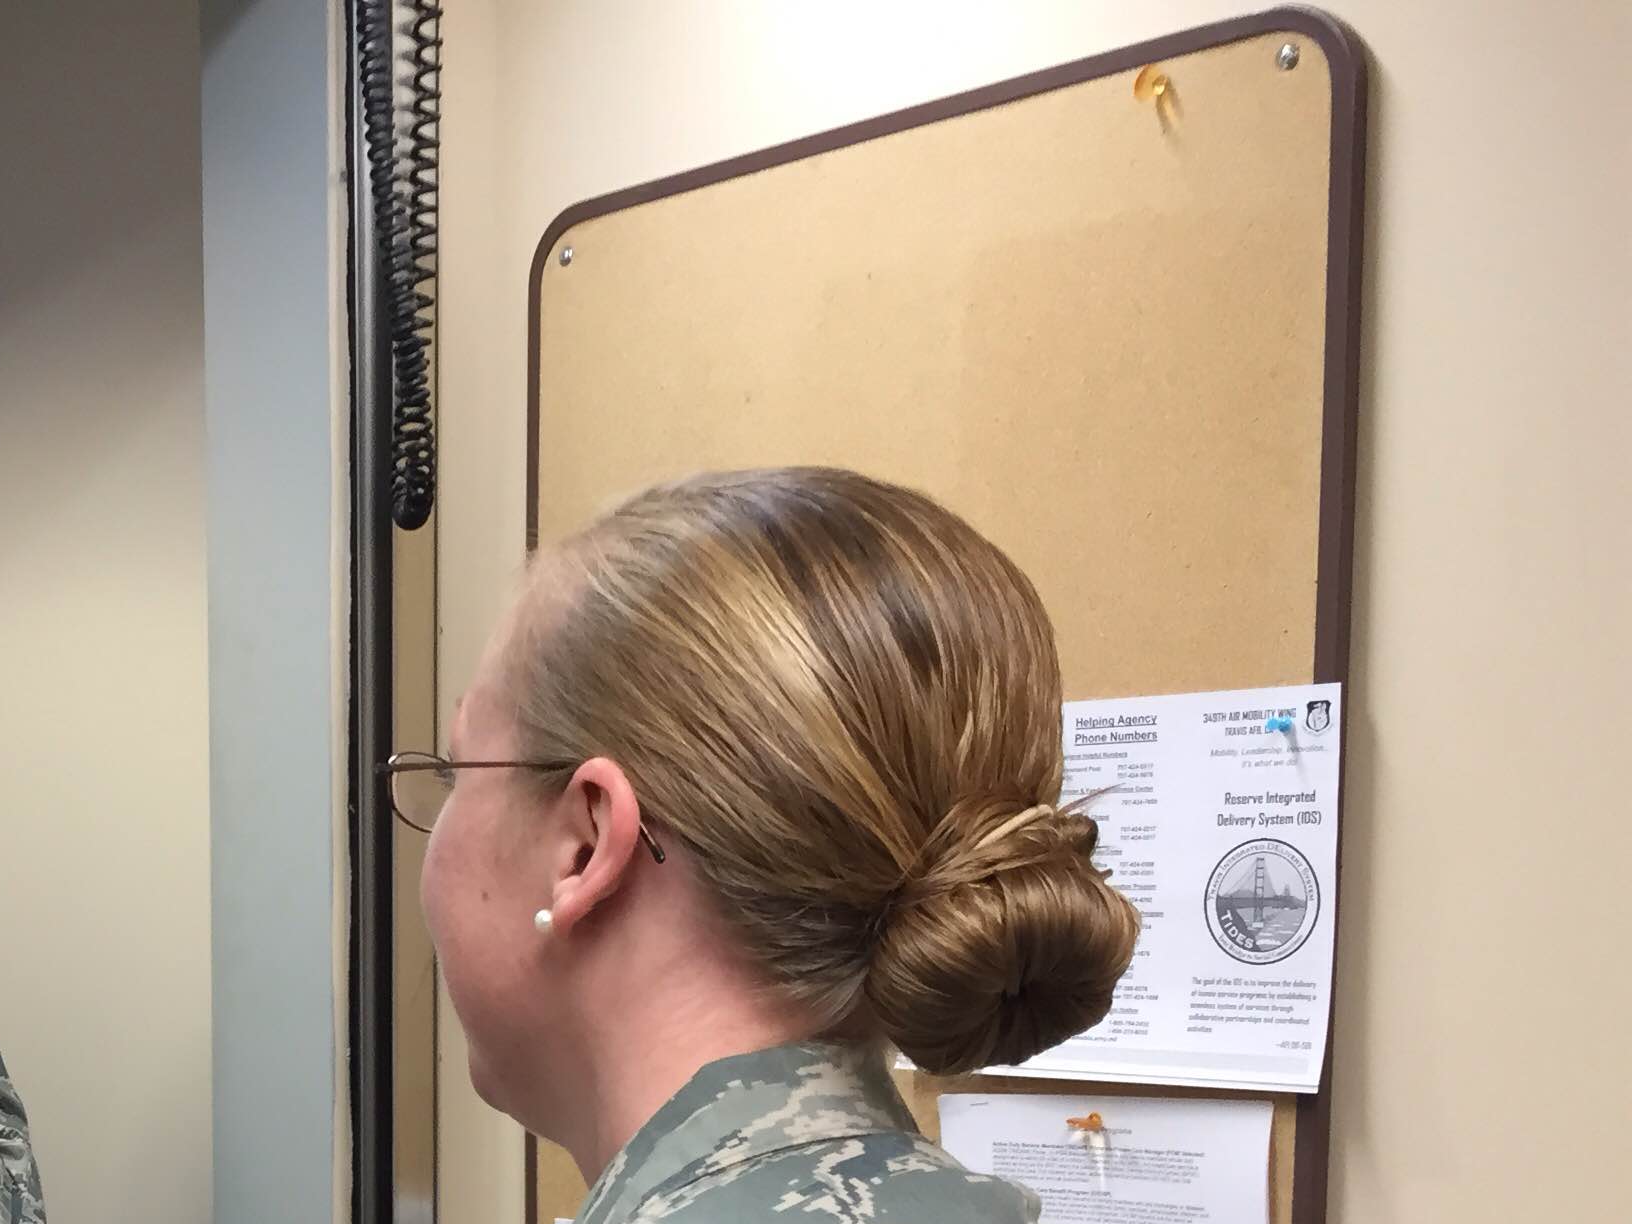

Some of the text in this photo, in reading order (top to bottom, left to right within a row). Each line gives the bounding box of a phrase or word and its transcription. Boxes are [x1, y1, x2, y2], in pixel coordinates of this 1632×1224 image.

[1076, 714, 1157, 728] Helping Agency
[1228, 711, 1241, 722] AIR
[1074, 730, 1158, 744] Phone Numbers
[1224, 789, 1316, 806] Reserve Integrated
[1217, 810, 1322, 828] Delivery System (IDS)
[1221, 909, 1255, 949] TIDES
